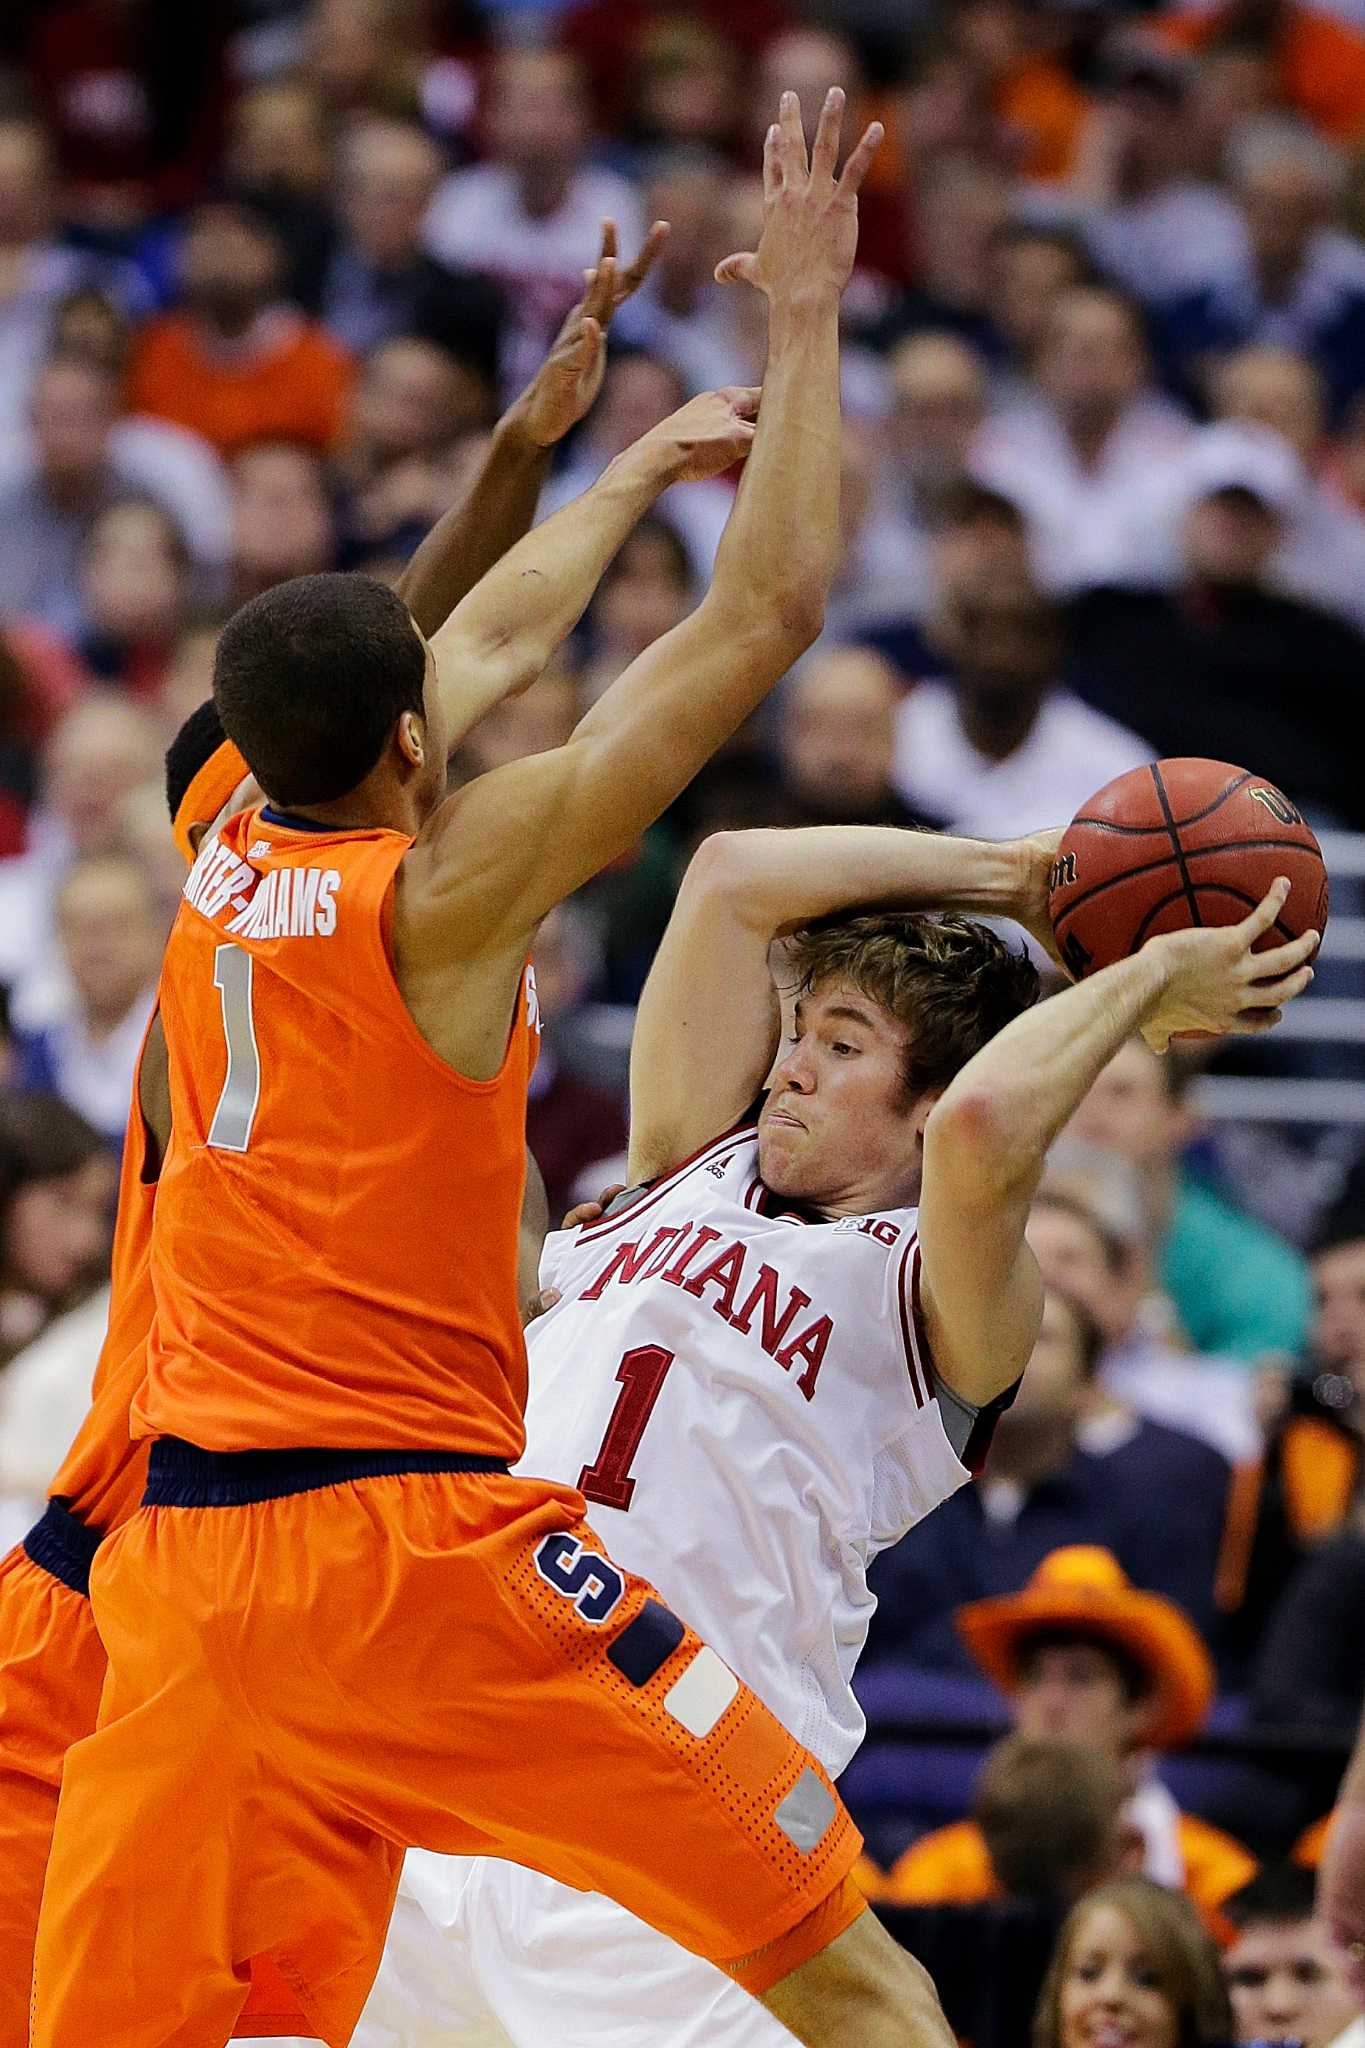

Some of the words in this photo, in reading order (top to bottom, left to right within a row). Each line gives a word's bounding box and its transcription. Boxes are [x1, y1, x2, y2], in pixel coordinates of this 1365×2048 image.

[208, 942, 260, 1152] 1
[577, 1344, 674, 1512] 1
[533, 1531, 625, 1627] S
